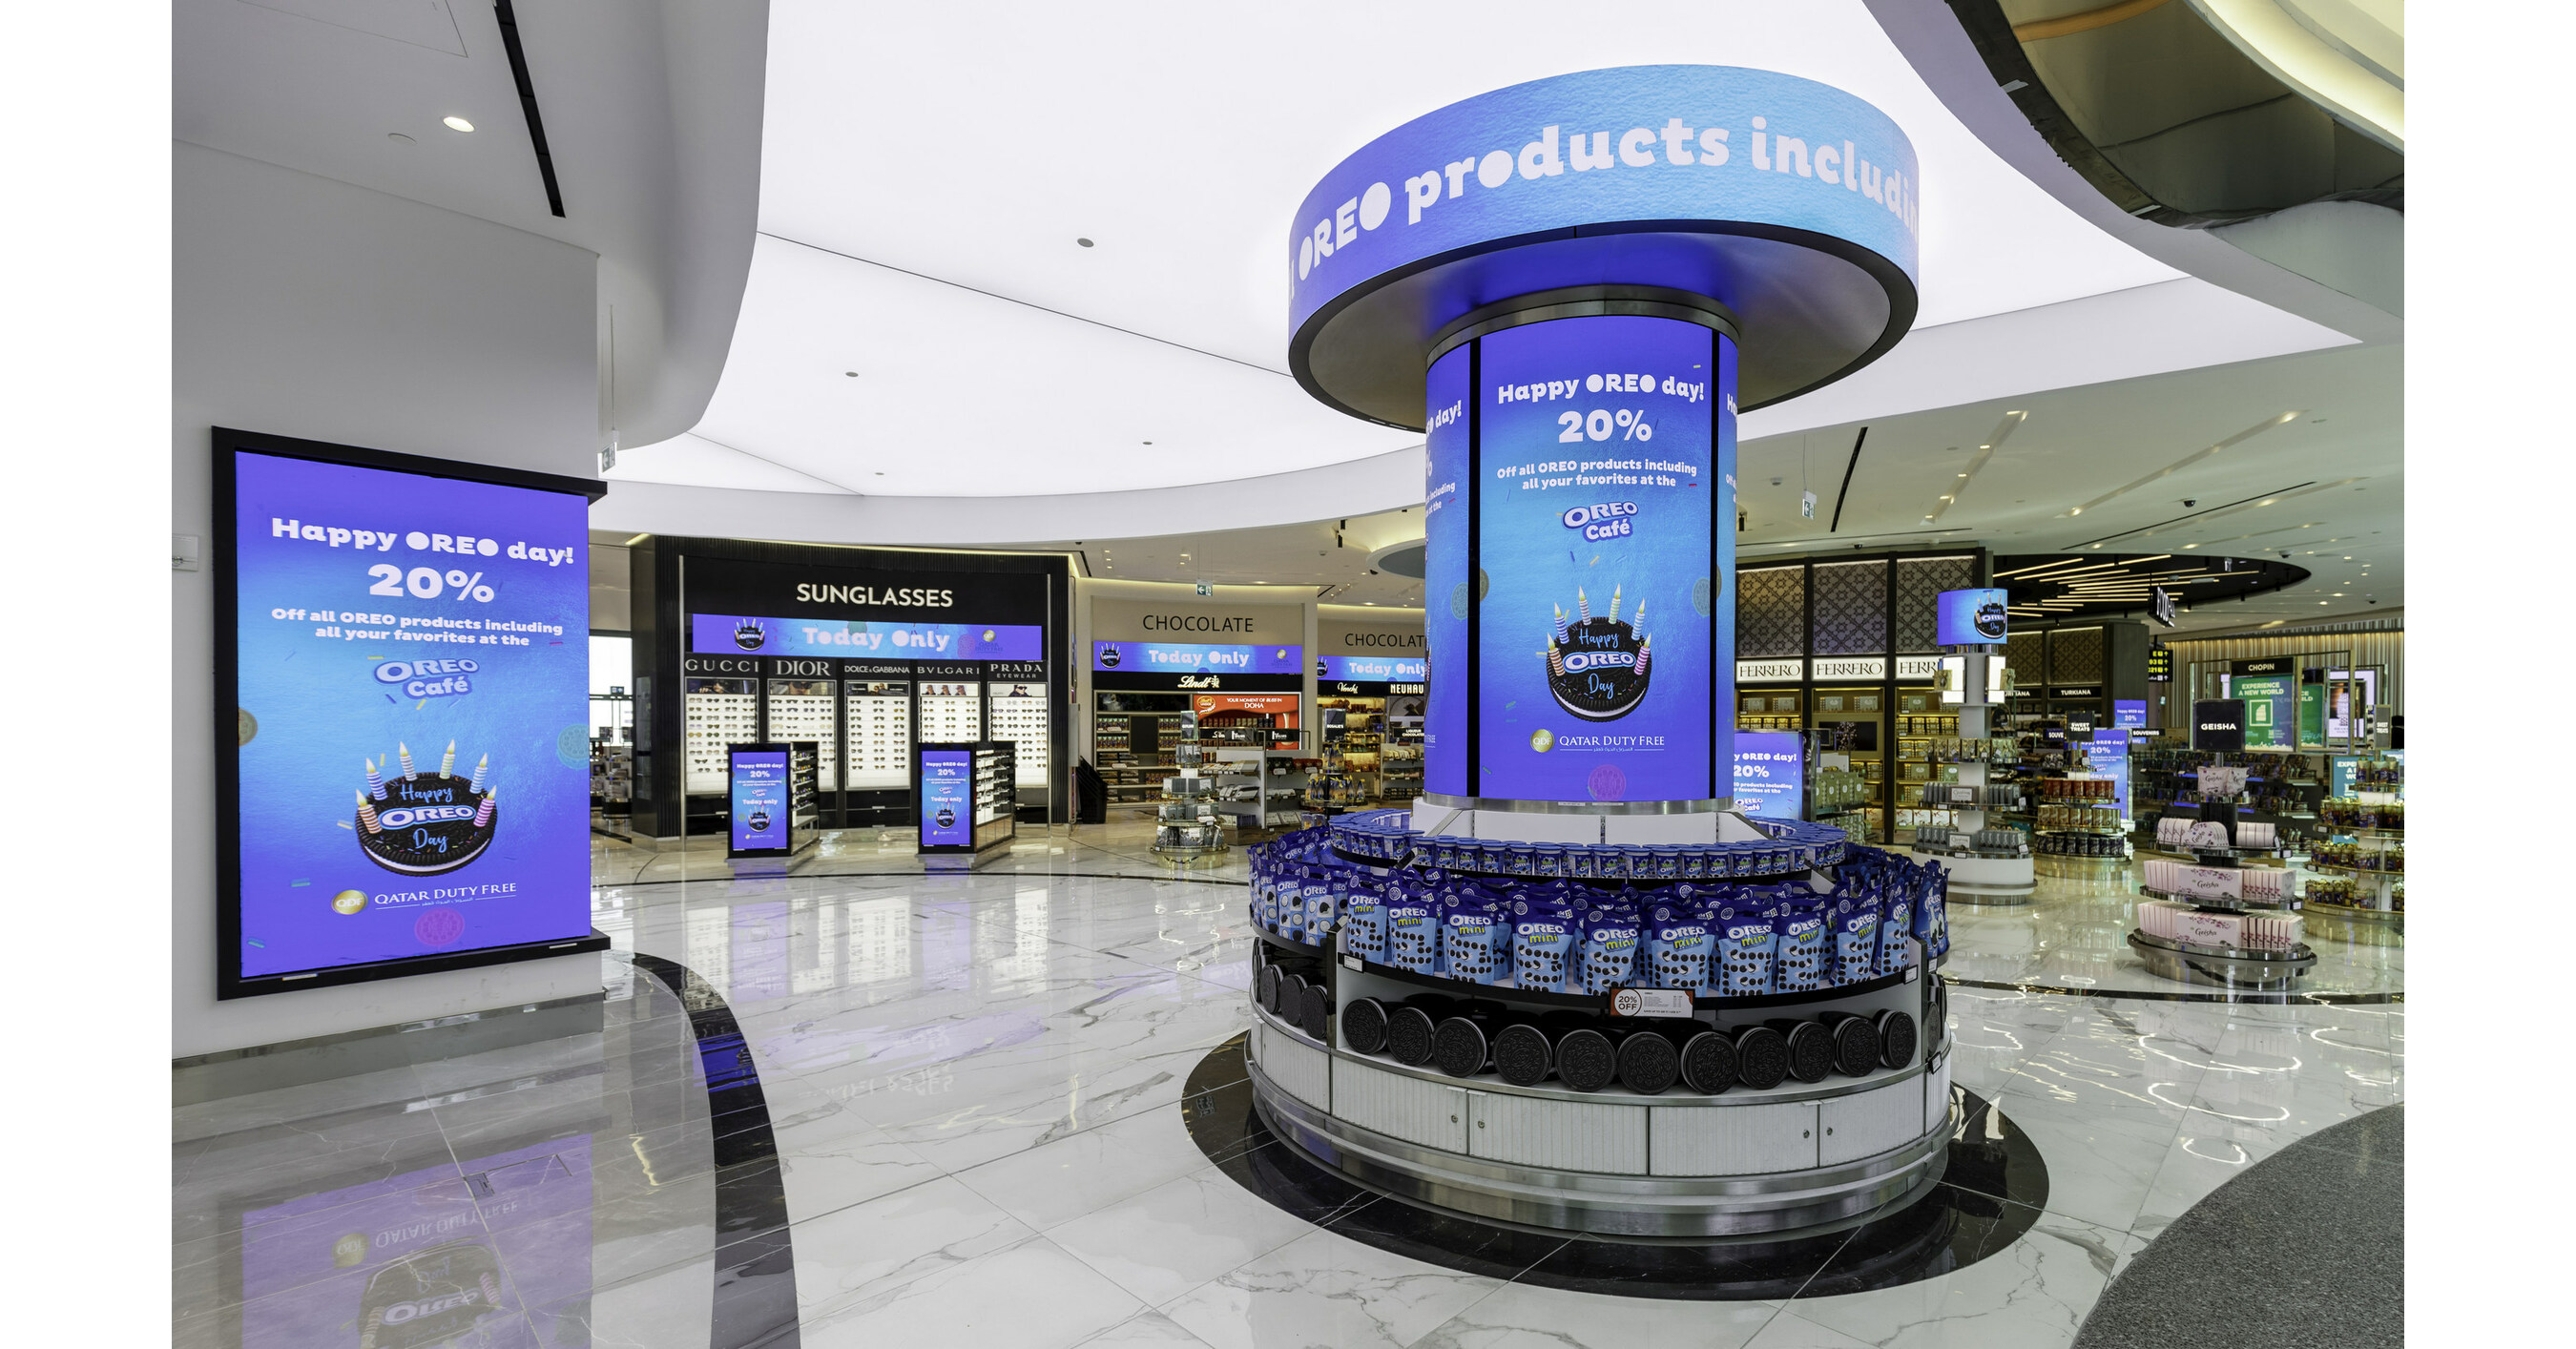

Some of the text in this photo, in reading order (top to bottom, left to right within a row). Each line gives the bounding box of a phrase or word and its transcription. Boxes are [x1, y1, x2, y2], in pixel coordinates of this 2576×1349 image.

[1299, 116, 1918, 280] OREO products includin
[1498, 373, 1704, 404] Happy OREO day!
[1435, 400, 1462, 427] day!
[1558, 409, 1652, 443] 20%
[1497, 459, 1696, 479] Off all OREO products including
[1522, 473, 1676, 490] all your favorites at the
[1564, 502, 1638, 528] OREO
[1586, 518, 1631, 540] Café
[272, 517, 573, 567] Happy OREO day!
[367, 564, 495, 603] 20%
[797, 583, 953, 608] SUNGLASSES
[271, 608, 563, 636] Off all OREO products including
[1143, 614, 1254, 633] CHOCOLATE
[315, 626, 530, 646] all your favorites at the
[802, 627, 950, 652] Today Only
[1345, 633, 1425, 648] CHOCOLAT
[1579, 628, 1620, 648] Happy
[685, 659, 758, 673] GUCCI
[1149, 650, 1249, 667] Today Only
[1565, 654, 1634, 670] OREO
[375, 659, 478, 683] OREO
[776, 660, 831, 676] DIOR
[990, 663, 1043, 673] PRADA
[1349, 663, 1394, 676] Today
[1739, 664, 1800, 677] FERRERO
[1817, 662, 1882, 675] FERRERO
[1900, 661, 1938, 674] FERR
[406, 676, 468, 696] Café
[1177, 675, 1212, 688] Lindt
[1390, 684, 1424, 694] NEUHAU
[1589, 673, 1615, 699] Day
[1560, 737, 1665, 746] QATAR DUTY FREE
[1773, 753, 1797, 762] day!
[1734, 765, 1770, 778] 20%
[400, 783, 453, 802] Happy
[381, 807, 474, 826] OREO
[413, 828, 448, 853] Day
[374, 882, 517, 904] QATAR DUTY FREE
[1278, 881, 1298, 892] OREO
[1303, 886, 1327, 897] OREO
[1349, 895, 1380, 905] OREO
[1389, 907, 1427, 918] OREO
[1450, 915, 1491, 925] OREO
[1397, 917, 1423, 926] mini
[1459, 924, 1485, 934] mini
[1518, 924, 1565, 935] OREO
[1788, 918, 1821, 935] OREO
[1847, 913, 1878, 932] OREO
[1528, 933, 1558, 944] mini
[1593, 928, 1638, 942] OREO
[1661, 926, 1706, 942] OREO
[1728, 925, 1771, 940] OREO
[1741, 933, 1768, 947] mini
[1605, 938, 1634, 950] mini
[1673, 935, 1702, 949] mini
